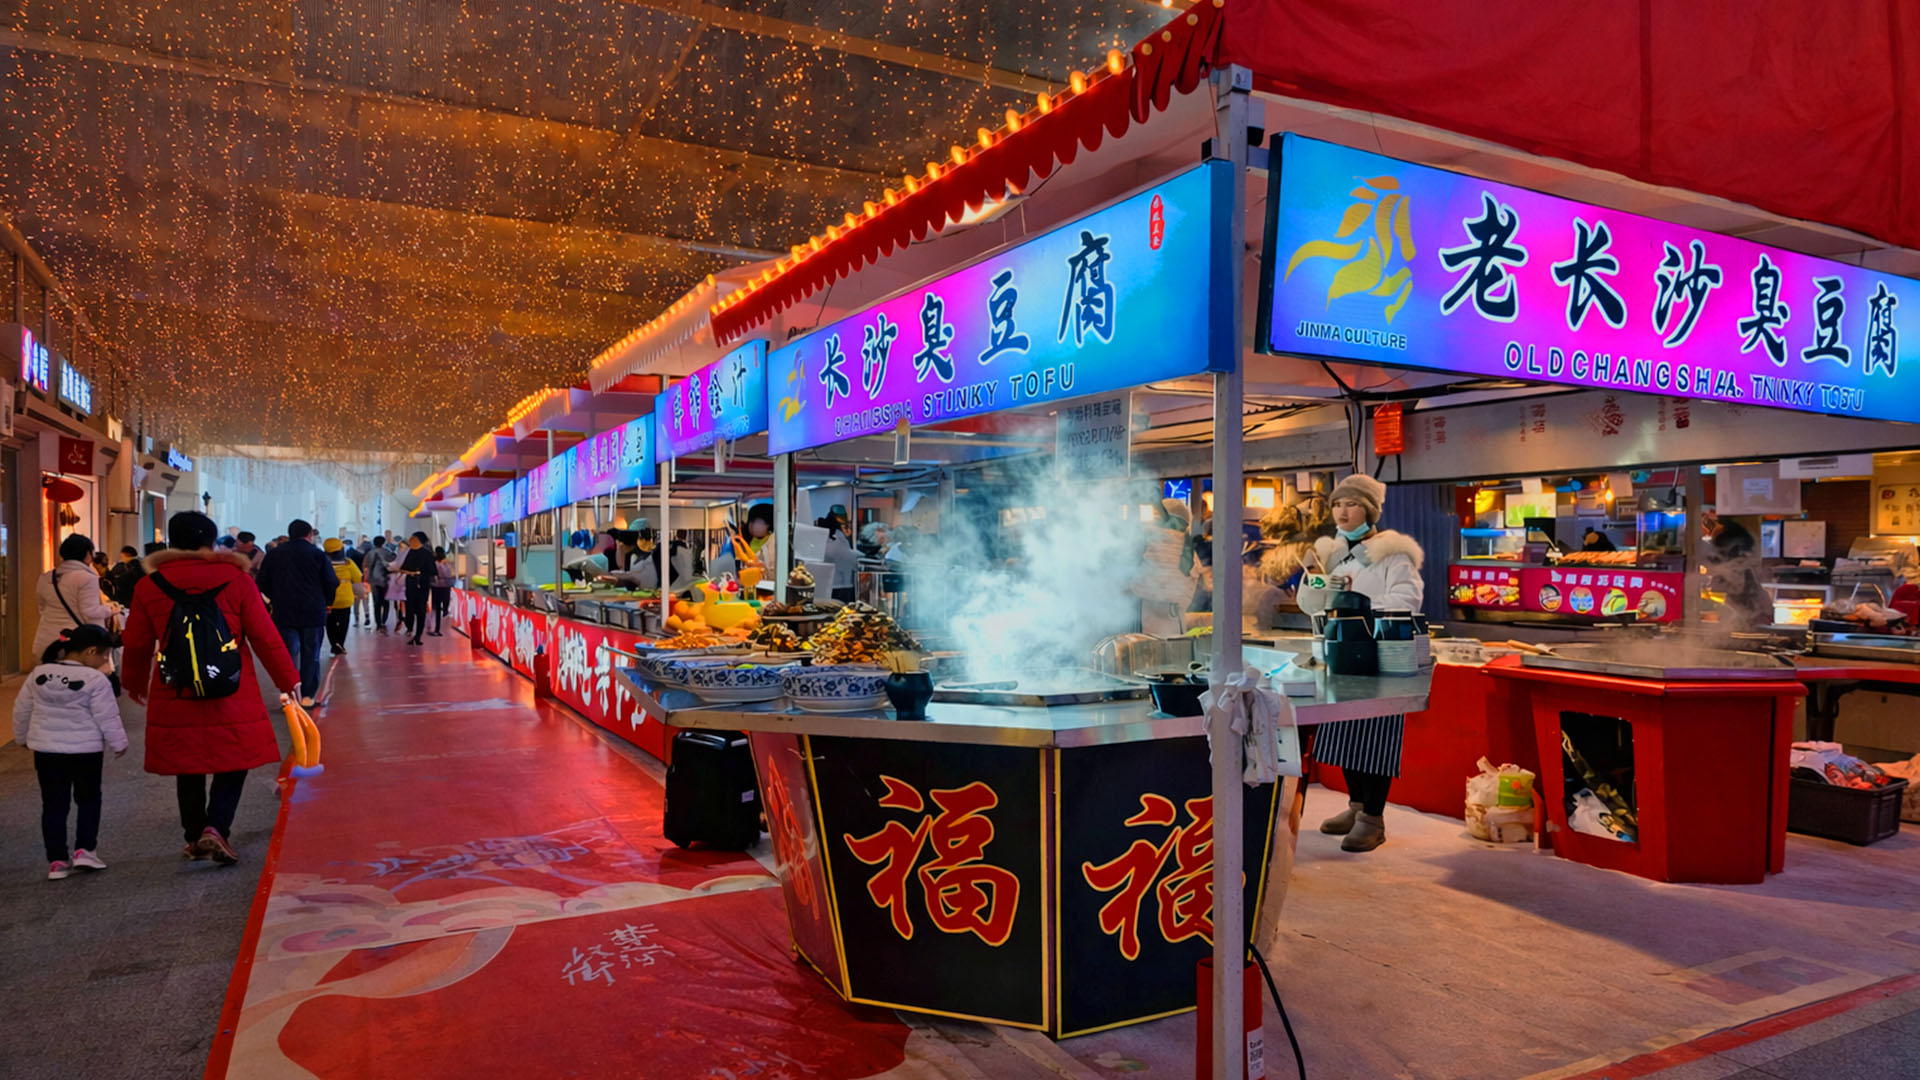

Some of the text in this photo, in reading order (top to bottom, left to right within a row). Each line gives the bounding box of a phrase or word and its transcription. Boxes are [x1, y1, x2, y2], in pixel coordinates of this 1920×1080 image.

[819, 230, 1115, 408] 长沙臭豆腐
[1296, 320, 1406, 350] JINMA CULTURE
[1438, 191, 1899, 378] 老长沙臭豆腐
[922, 380, 998, 418] STINKY
[1010, 362, 1074, 400] TOFU
[844, 775, 1020, 946] 福
[1082, 793, 1245, 960] 福
